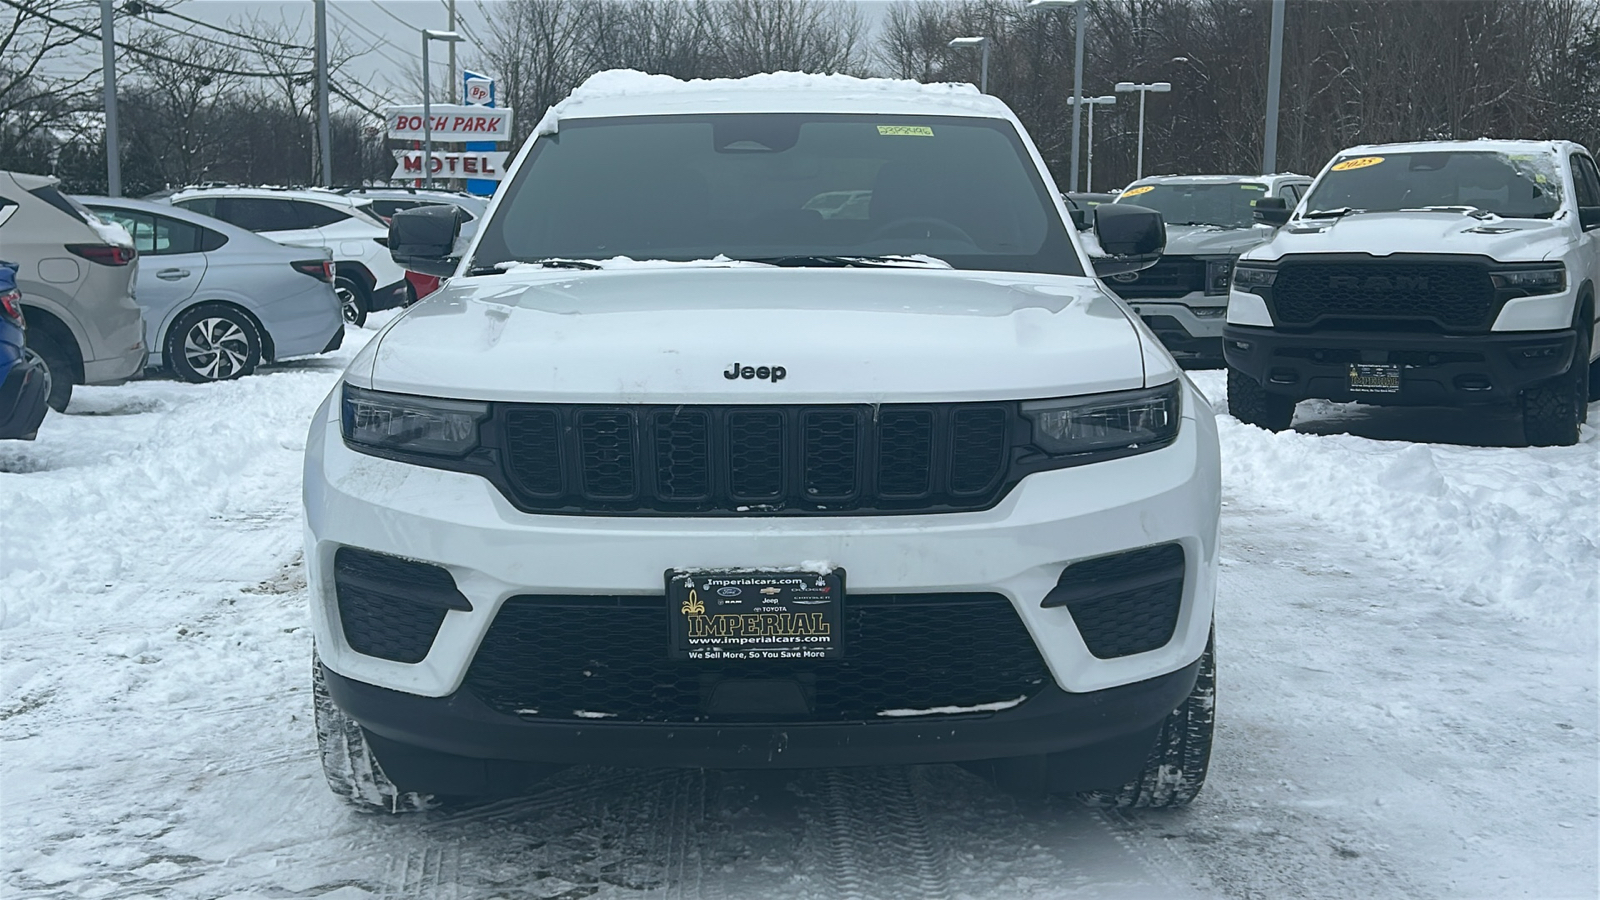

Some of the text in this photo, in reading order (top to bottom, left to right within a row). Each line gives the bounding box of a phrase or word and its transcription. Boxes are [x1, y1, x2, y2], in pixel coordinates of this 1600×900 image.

[472, 87, 486, 99] BP
[452, 116, 501, 132] PARK
[403, 156, 495, 174] MOTEL
[723, 362, 787, 383] Jeep
[707, 578, 803, 587] Imperialcars.com
[688, 613, 830, 637] IMPERIAL
[688, 636, 831, 645] www.imperialcars.com
[688, 651, 703, 659] We
[704, 651, 720, 659] Sell
[722, 651, 747, 660] More,
[748, 651, 760, 659] So
[803, 650, 825, 658] More
